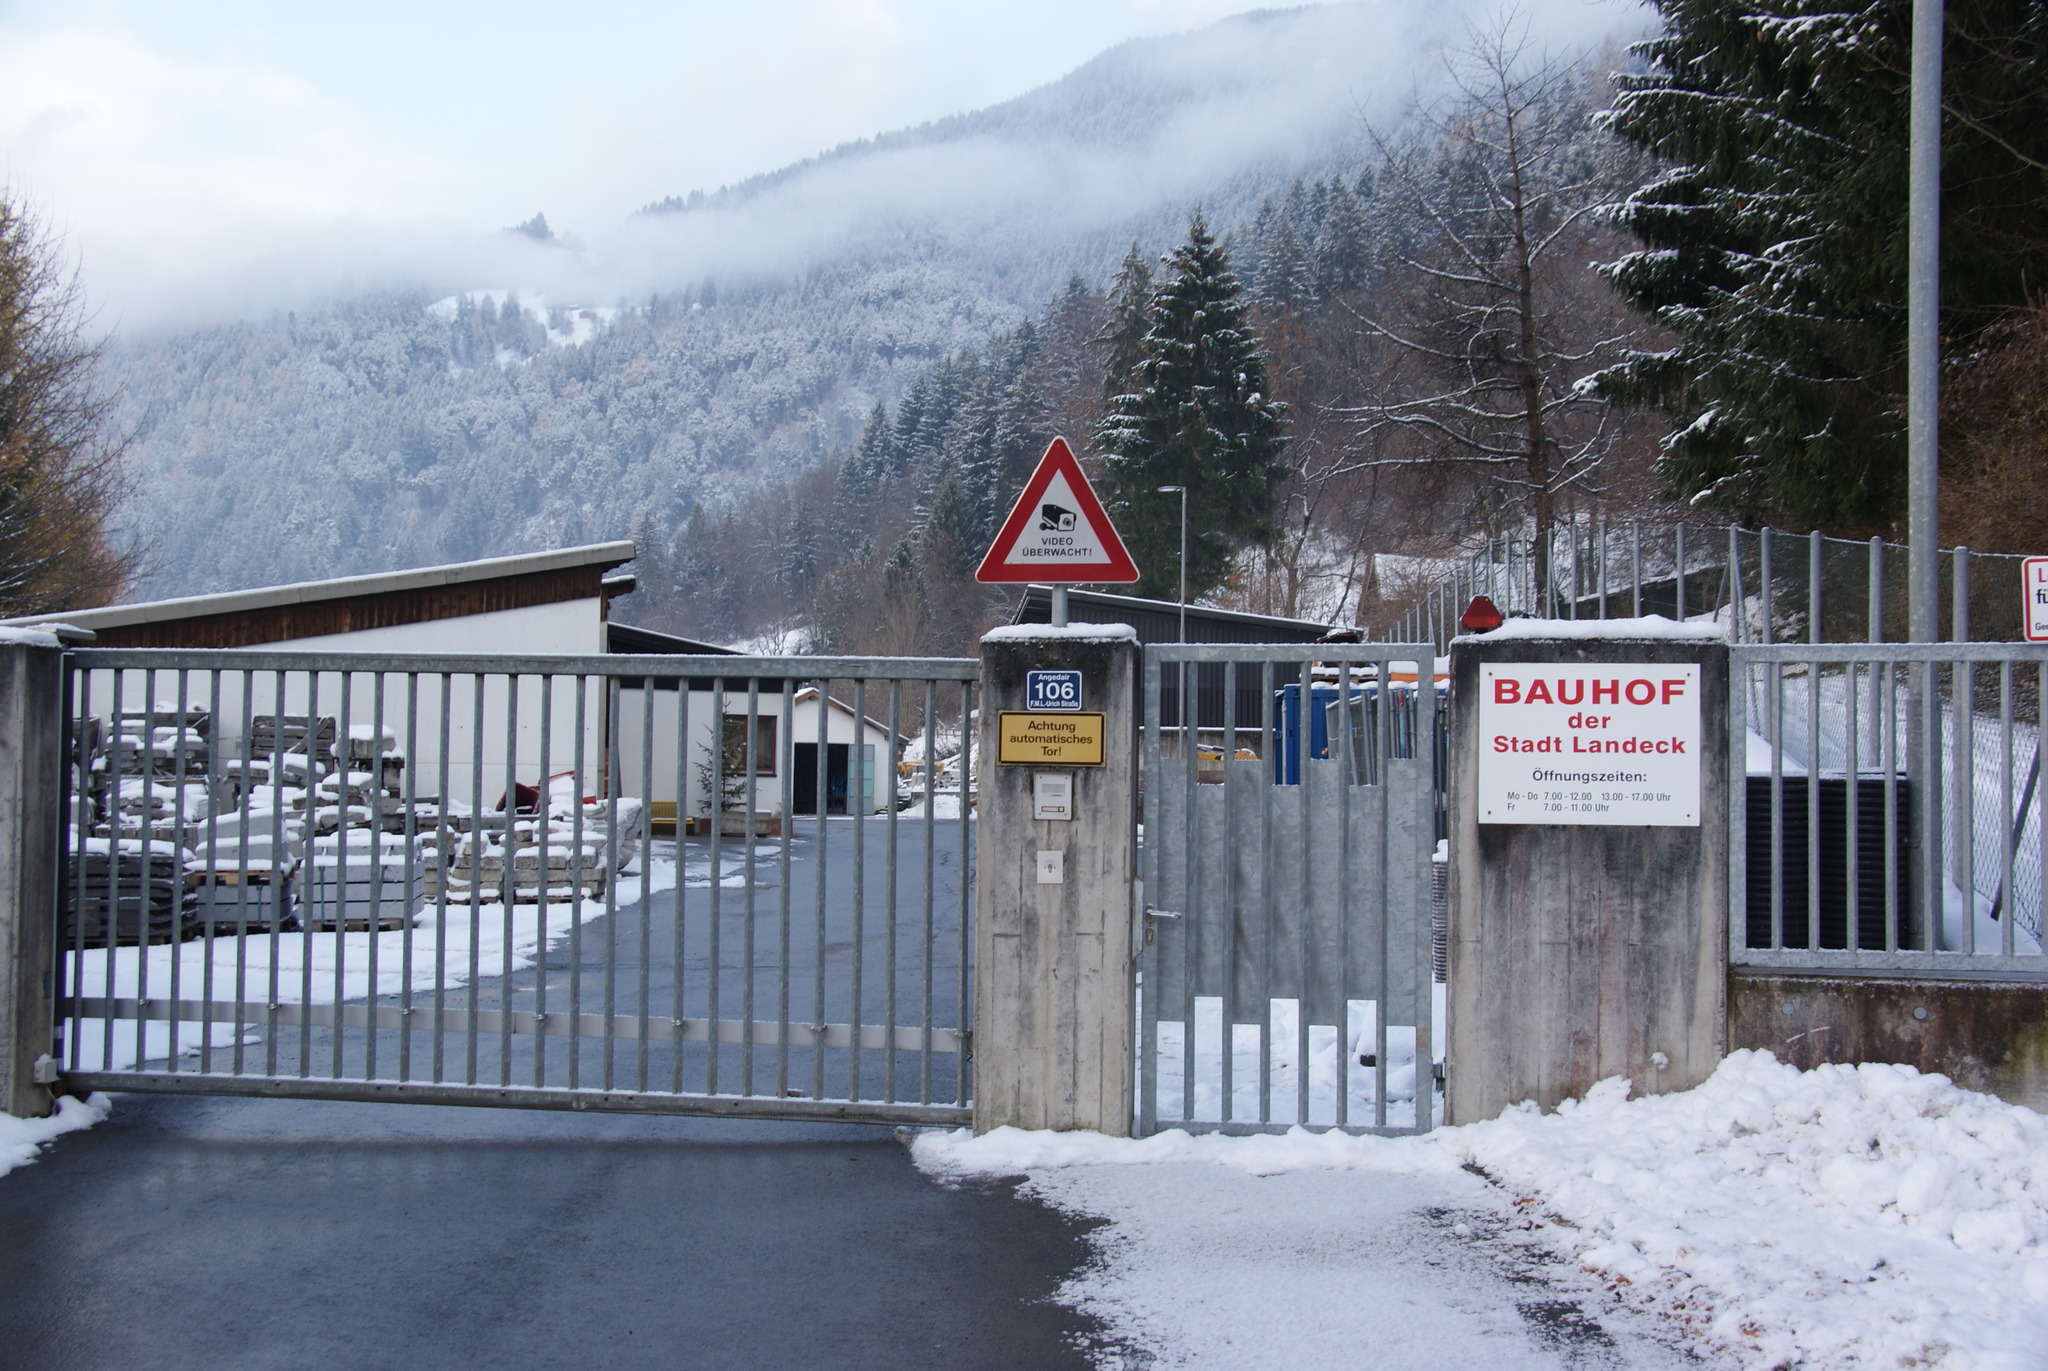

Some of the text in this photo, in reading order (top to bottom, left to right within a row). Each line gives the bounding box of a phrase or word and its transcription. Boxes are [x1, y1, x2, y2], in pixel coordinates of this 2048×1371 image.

[1042, 537, 1073, 546] VIDEO
[1022, 547, 1092, 557] ÜBERWACHT!
[1038, 673, 1071, 682] Angedair
[1035, 682, 1074, 700] 106
[1494, 679, 1686, 705] BAUHOF
[1061, 700, 1079, 708] Straße
[1568, 712, 1611, 729] der
[1027, 720, 1076, 733] Achtung
[1009, 734, 1093, 744] automatisches
[1494, 735, 1686, 754] Stadt Landeck
[1041, 746, 1062, 757] Tor!
[1532, 767, 1647, 784] Öffnungszeiten:
[1507, 791, 1520, 800] Mo
[1527, 791, 1538, 800] Do
[1544, 792, 1563, 801] 7.00
[1570, 792, 1592, 801] 12.00
[1601, 792, 1623, 801] 13.00
[1631, 793, 1653, 802] 17.00
[1656, 793, 1671, 802] Uhr
[1507, 803, 1516, 811] Fr
[1543, 803, 1562, 812] 7.00
[1571, 803, 1592, 812] 11.00
[1594, 803, 1610, 812] Uhr
